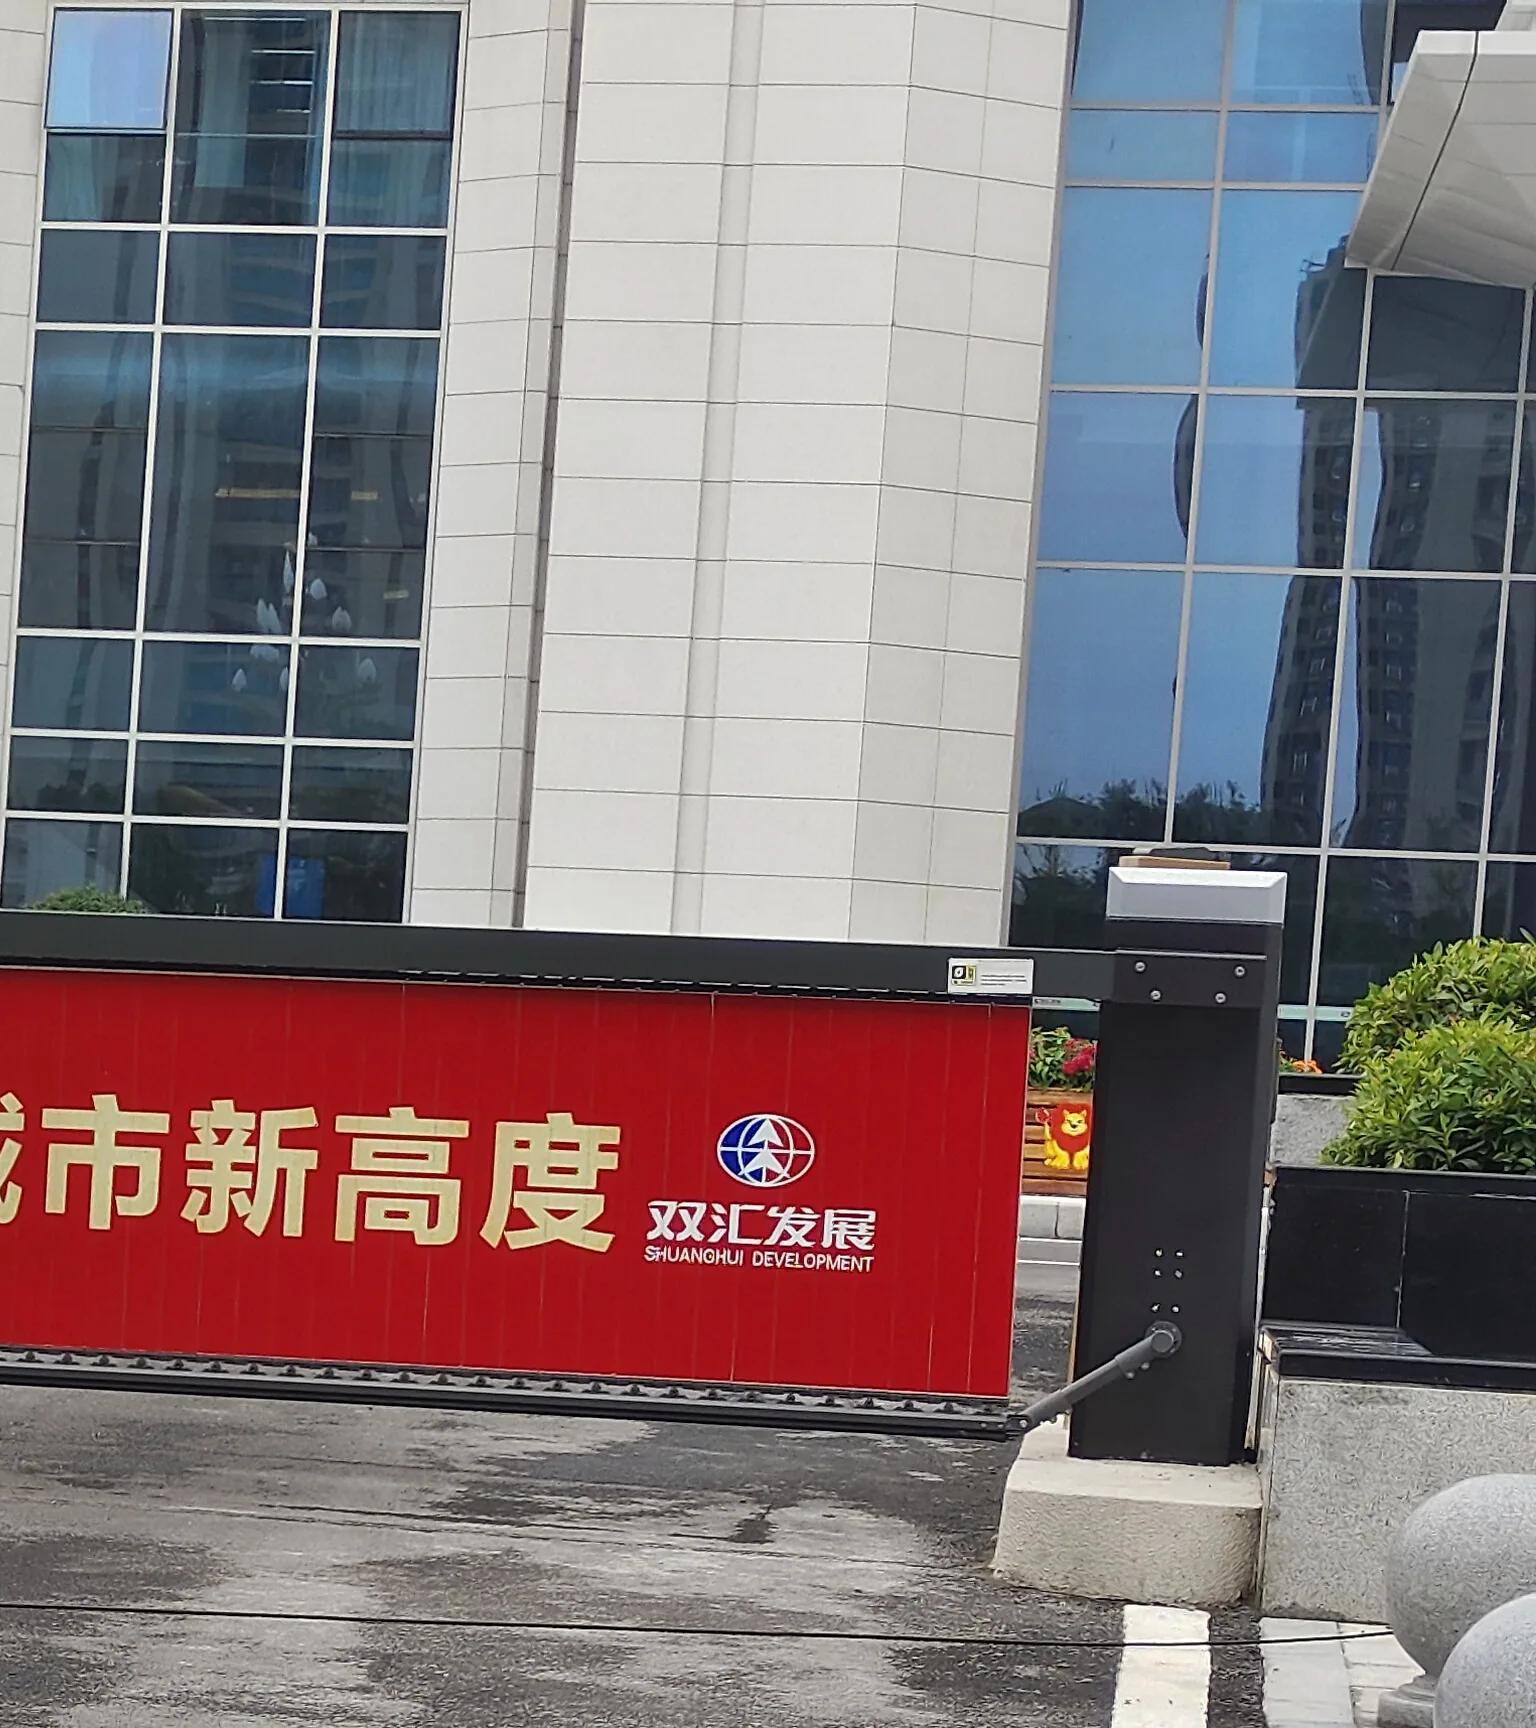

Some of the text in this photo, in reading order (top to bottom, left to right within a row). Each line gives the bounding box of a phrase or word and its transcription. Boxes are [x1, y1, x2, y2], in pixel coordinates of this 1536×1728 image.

[646, 1200, 877, 1251] 双汇发展
[644, 1245, 875, 1273] SHUANGHUI DEVELOPMENT
